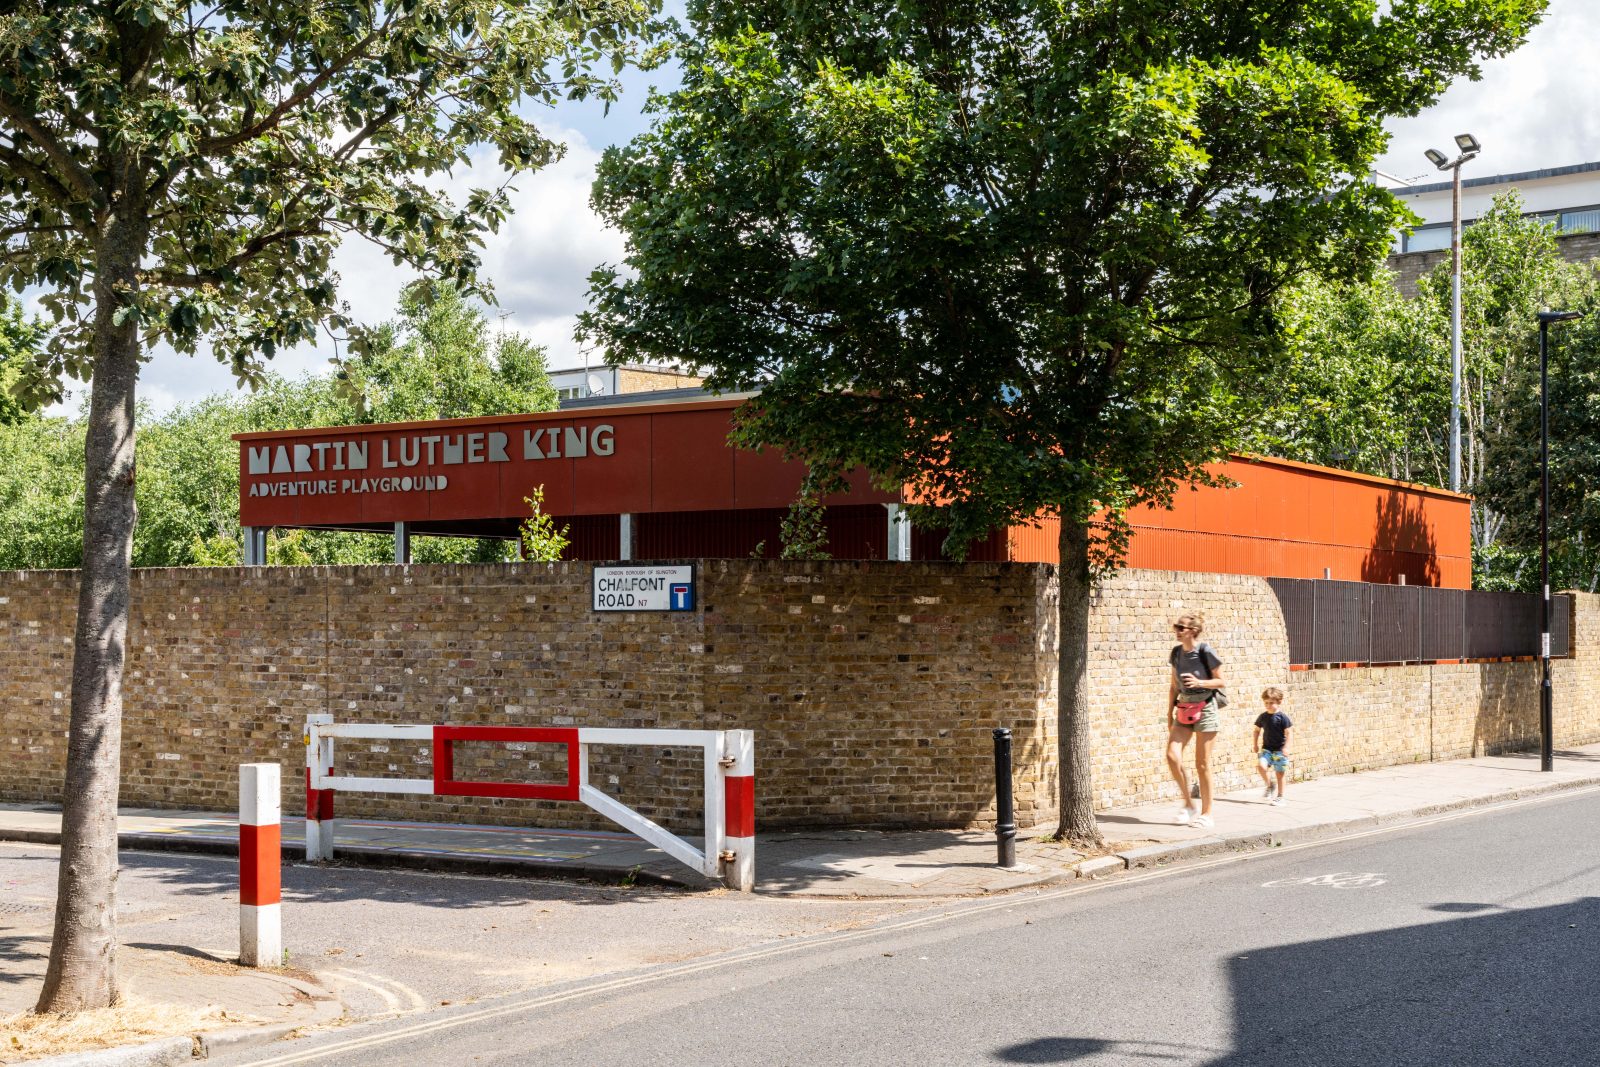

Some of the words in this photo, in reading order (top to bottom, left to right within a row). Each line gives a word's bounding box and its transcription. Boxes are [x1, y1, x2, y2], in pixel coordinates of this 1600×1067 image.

[249, 441, 368, 474] MARTIN
[382, 432, 510, 468] LUTHER
[523, 424, 614, 460] KING
[249, 477, 337, 497] ADVENTURE
[342, 475, 448, 494] PLAYGROUND
[599, 578, 665, 591] CHALFONT
[599, 594, 634, 607] ROAD
